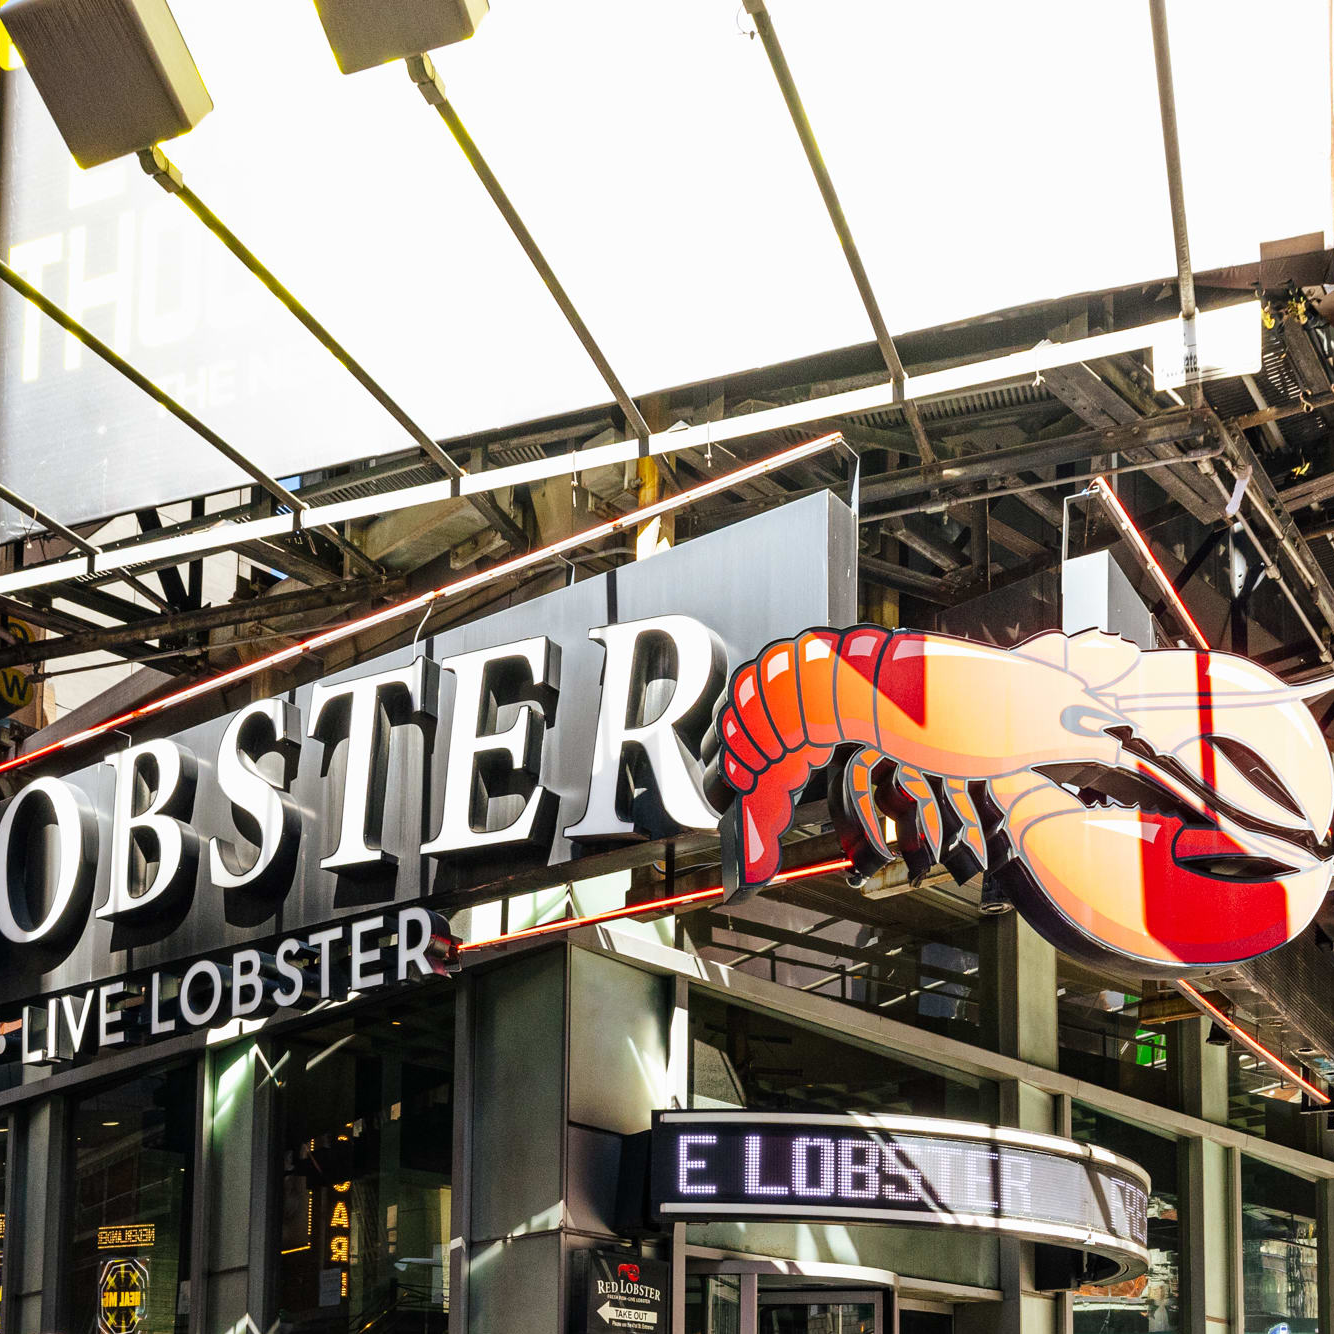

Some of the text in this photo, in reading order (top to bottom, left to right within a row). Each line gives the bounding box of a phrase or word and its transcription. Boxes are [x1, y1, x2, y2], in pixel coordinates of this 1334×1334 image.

[22, 990, 124, 1066] LIVE
[151, 907, 435, 1034] LOBSTER
[678, 1134, 718, 1194] E
[744, 1134, 1033, 1213] LOBSTER
[596, 1279, 662, 1302] RED LOBSTER
[614, 1309, 648, 1321] TAKE OUT
